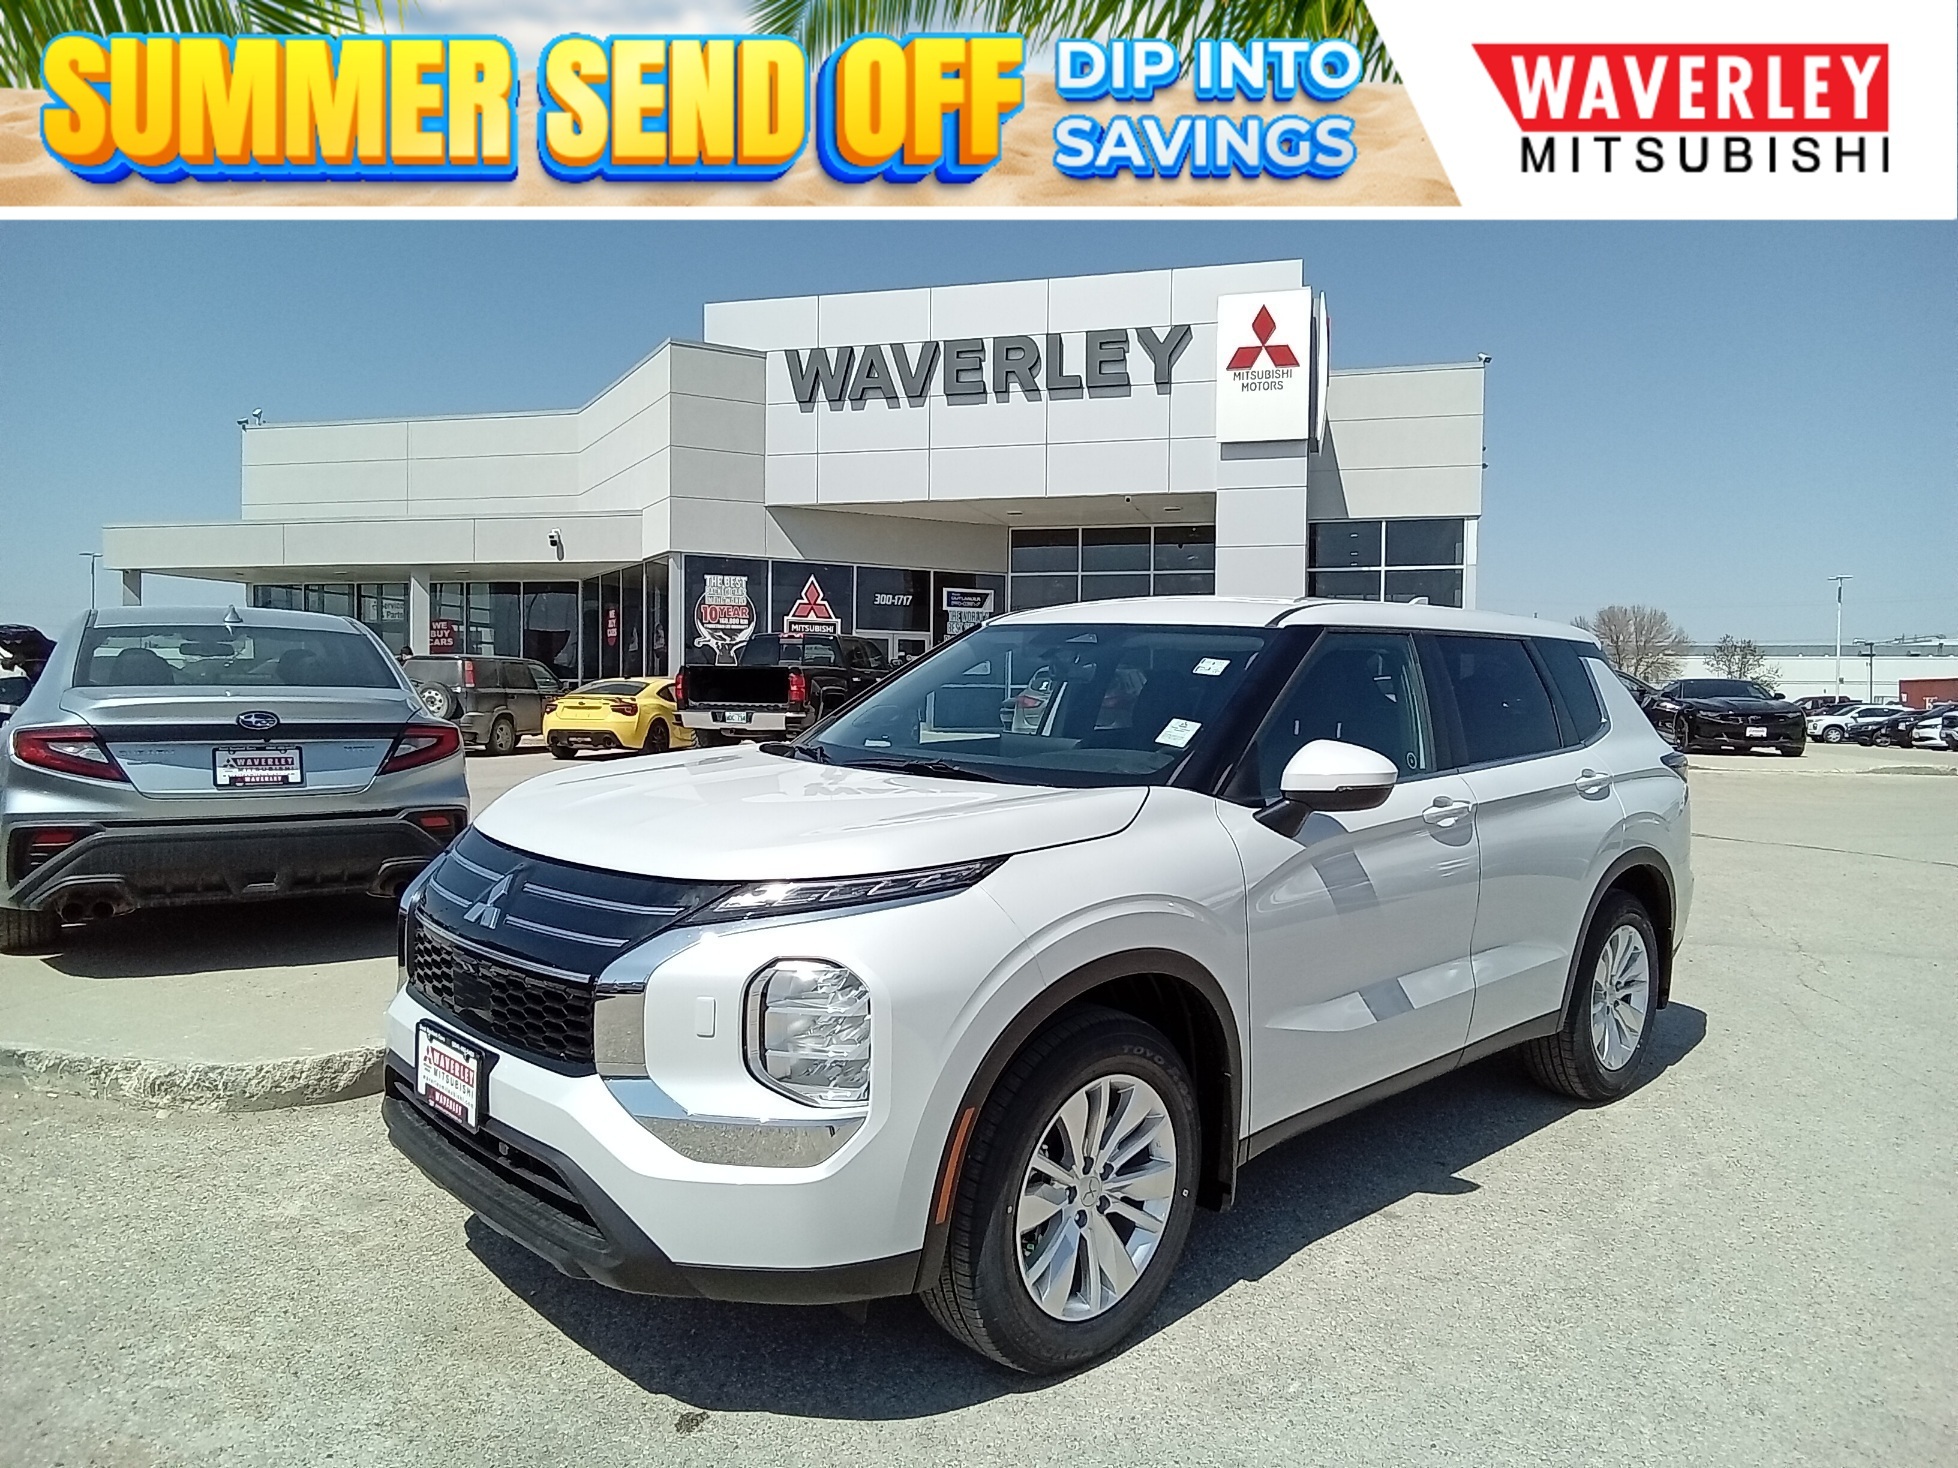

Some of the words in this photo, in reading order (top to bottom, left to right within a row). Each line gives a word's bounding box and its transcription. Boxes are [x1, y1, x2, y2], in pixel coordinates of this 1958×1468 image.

[785, 324, 1192, 412] WAVERLEY
[1233, 369, 1293, 381] MITSUBISHI
[1241, 381, 1284, 392] MOTORS
[704, 574, 723, 587] THE
[724, 576, 748, 588] BEST
[874, 593, 912, 606] 300-1717
[701, 605, 719, 623] 10
[719, 606, 749, 618] YEAR
[791, 624, 834, 633] MITSUBISHI
[236, 758, 293, 766] WAVERLEY
[1122, 1045, 1165, 1065] TOYO
[433, 1048, 474, 1087] WAVERLEY
[433, 1067, 474, 1099] MITSUBISHI
